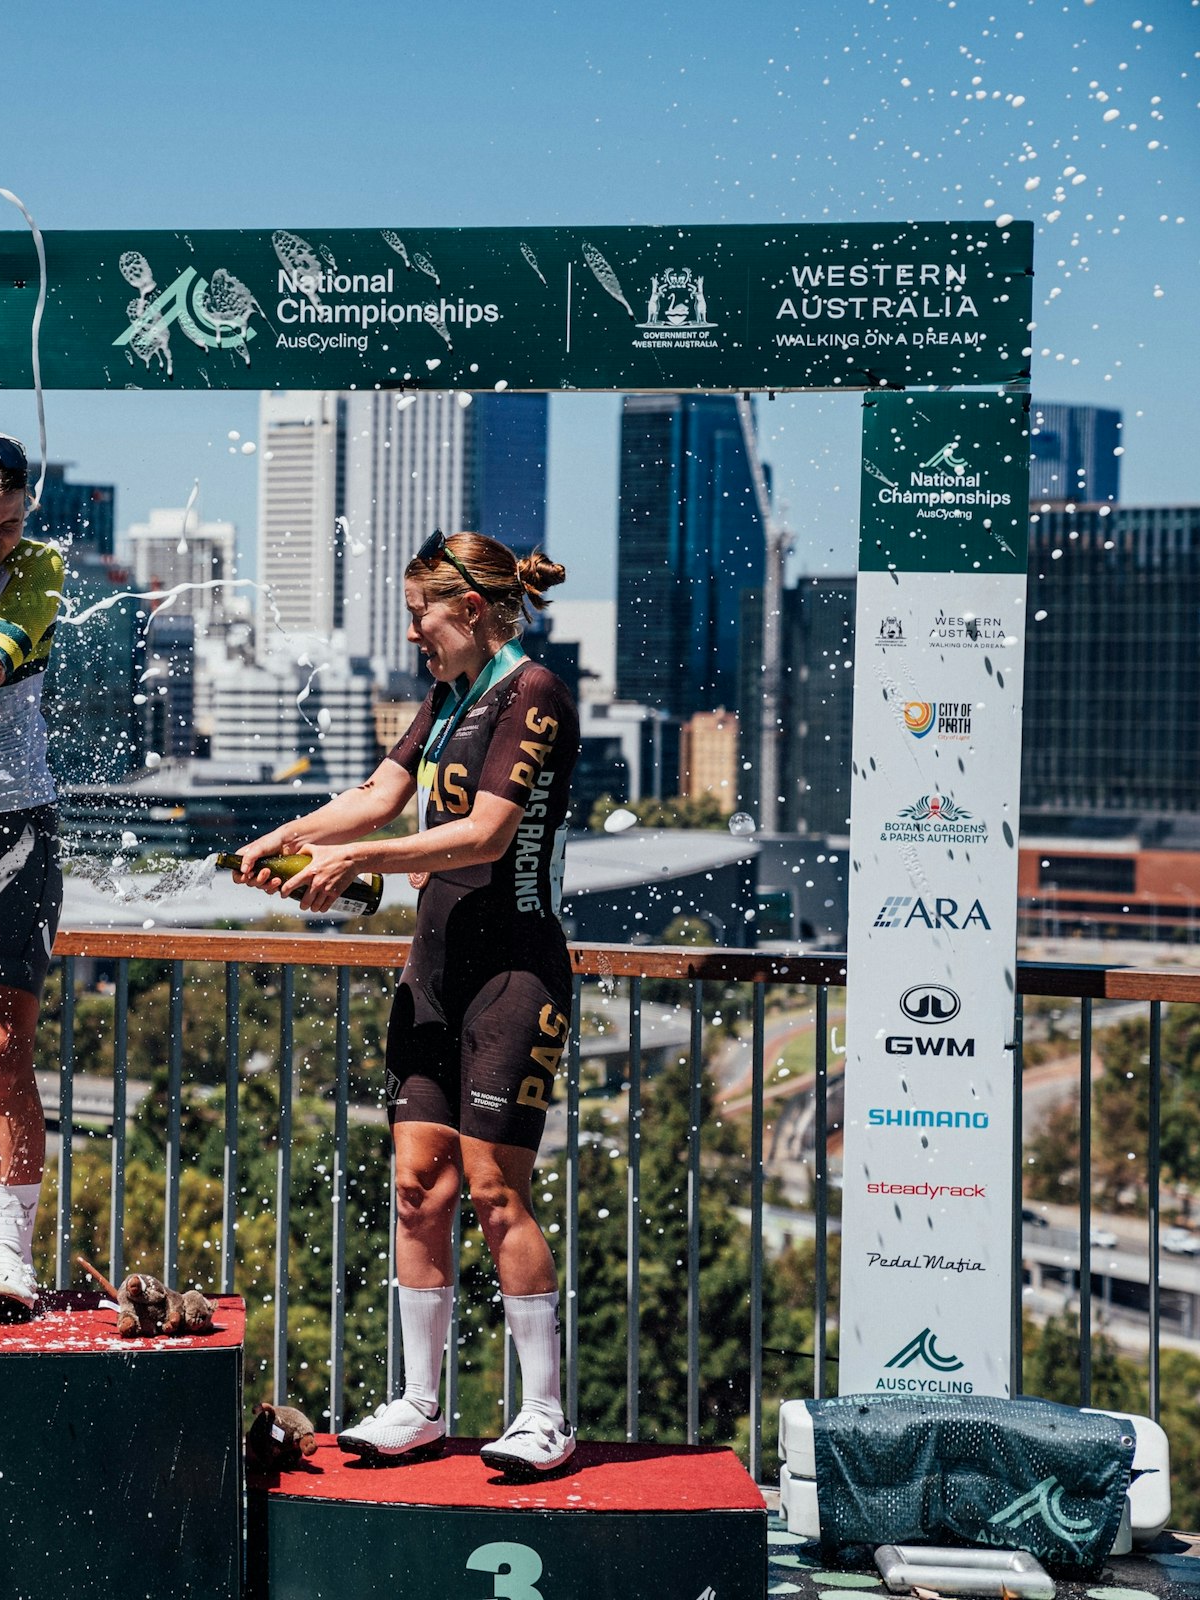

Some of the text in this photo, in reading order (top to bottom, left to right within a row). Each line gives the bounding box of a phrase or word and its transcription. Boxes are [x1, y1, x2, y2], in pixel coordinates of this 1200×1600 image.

[277, 268, 394, 293] National
[791, 263, 967, 288] WESTERN
[276, 298, 499, 329] Championships
[776, 296, 979, 320] AUSTRALIA
[275, 332, 369, 352] AusCycling
[635, 340, 718, 349] WESTERN AUSTRALIA
[643, 331, 710, 340] GOVERNMENT OF
[776, 331, 980, 348] WALKING ON A DREAM
[910, 471, 981, 487] National
[934, 617, 1002, 627] WESERN
[938, 702, 972, 717] CITY OF
[938, 718, 971, 734] PERTH
[509, 706, 559, 789] PAS
[428, 763, 471, 815] AS
[884, 822, 985, 834] BOTANIC GARDENS
[514, 771, 555, 914] PAS RACING
[880, 833, 989, 844] & PARKS AUTHORITY
[904, 897, 992, 931] ARA
[885, 1036, 975, 1057] GWM
[516, 1004, 569, 1113] PAS
[474, 1097, 500, 1108] STUDIOS
[481, 1092, 508, 1104] NORMAL
[868, 1109, 989, 1129] SHIMANO
[867, 1182, 986, 1200] steadyrack
[866, 1253, 986, 1272] Pedal Mafia
[875, 1377, 974, 1394] AUSCYCLING
[465, 1541, 543, 1600] 3
